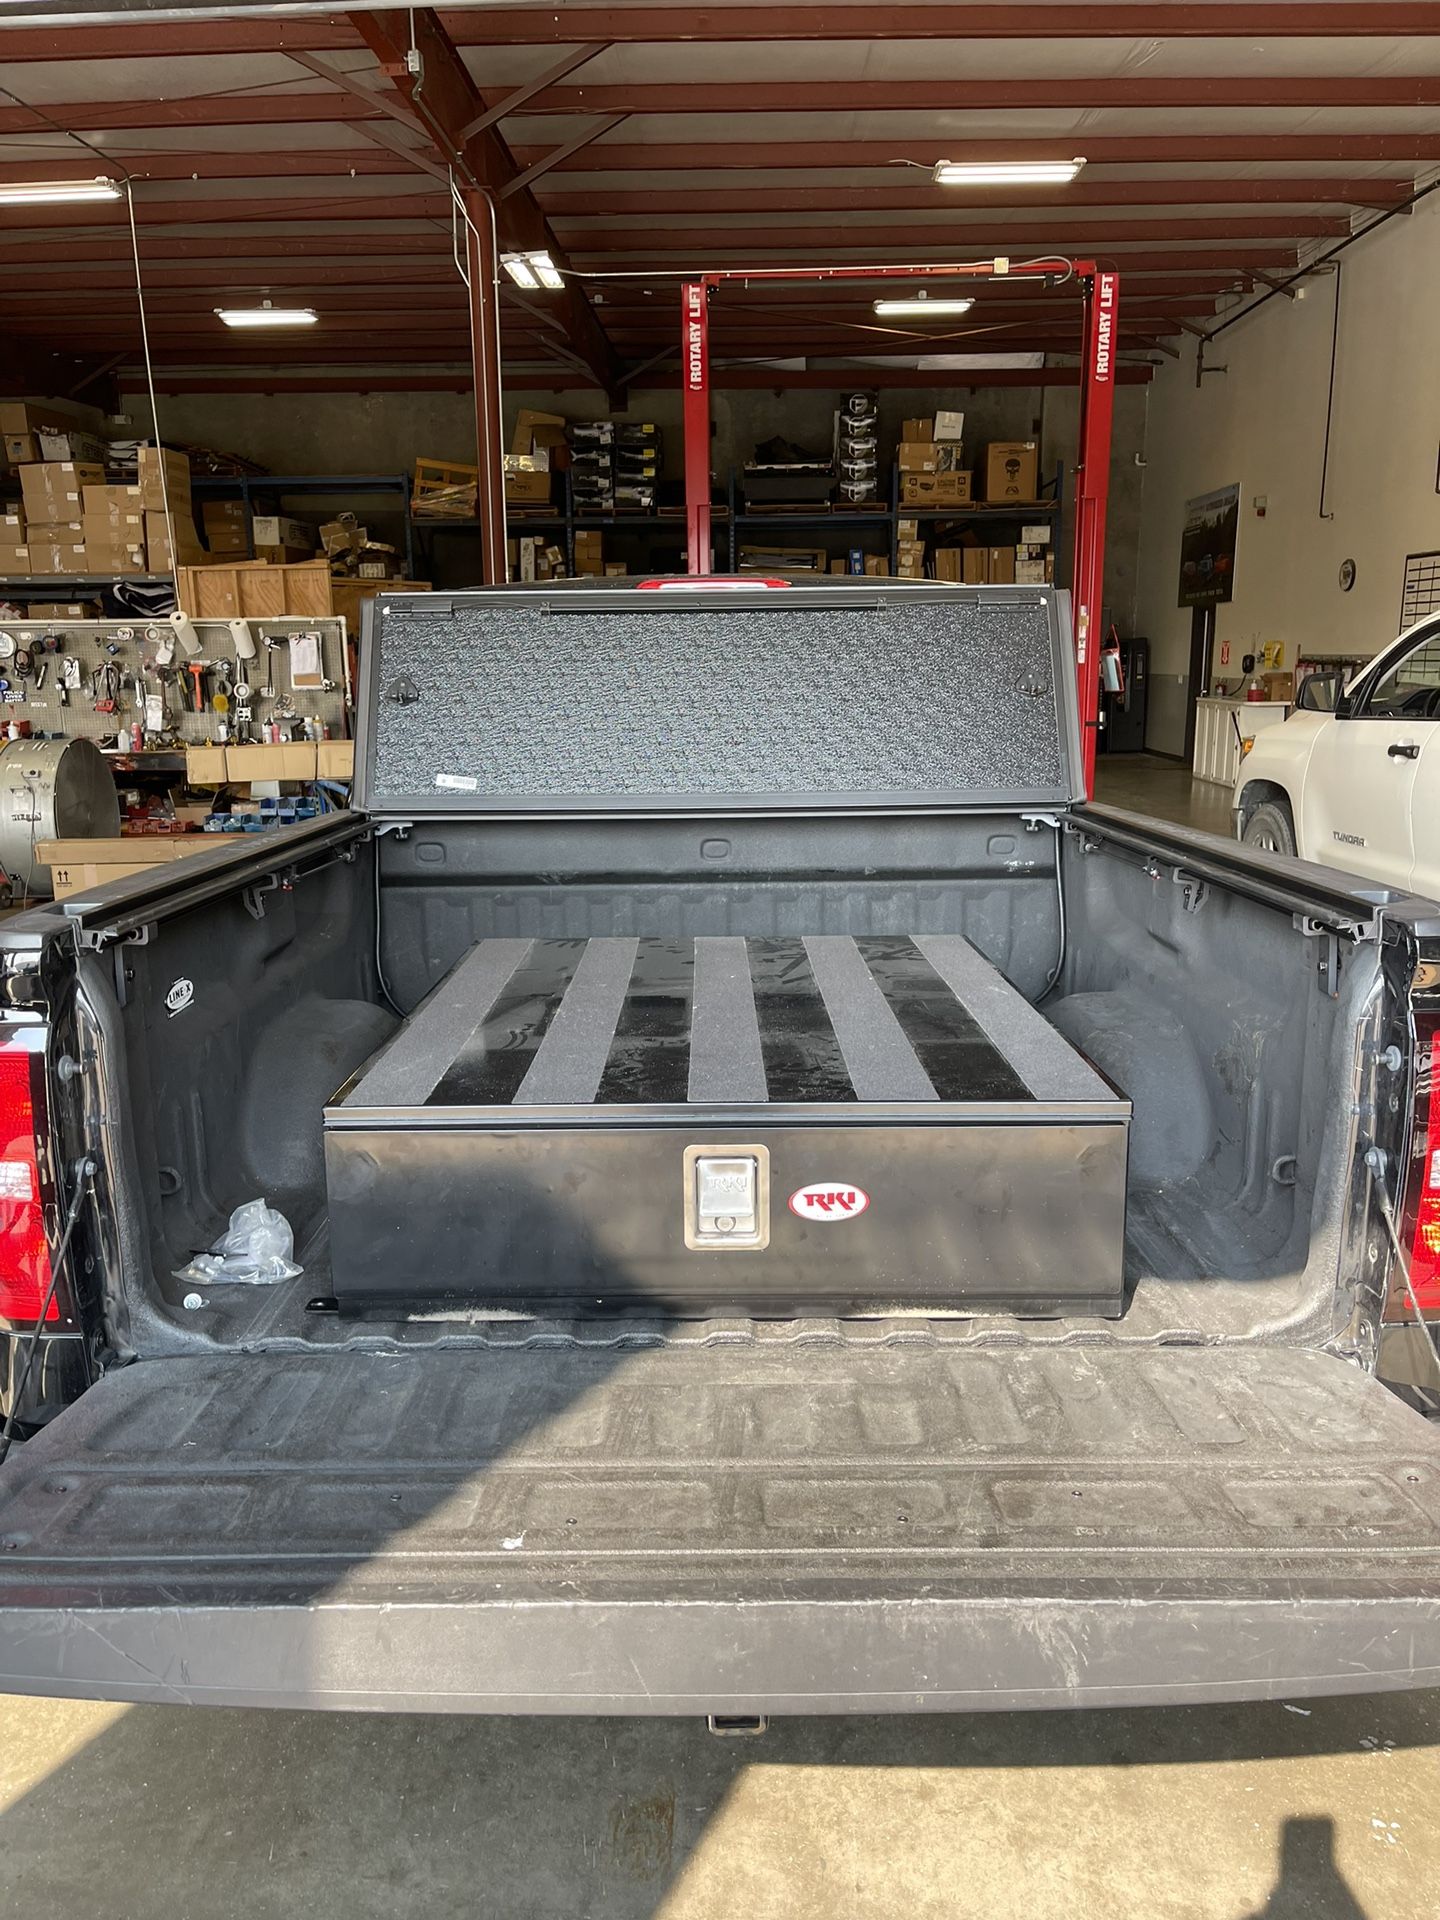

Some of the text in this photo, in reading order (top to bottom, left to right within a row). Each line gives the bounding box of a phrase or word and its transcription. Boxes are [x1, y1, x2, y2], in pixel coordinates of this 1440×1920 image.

[689, 285, 702, 382] ROTARY LIFT
[1097, 274, 1114, 373] ROTARY LIFT
[1332, 830, 1365, 847] TUNDRA
[803, 1191, 856, 1212] RKI
